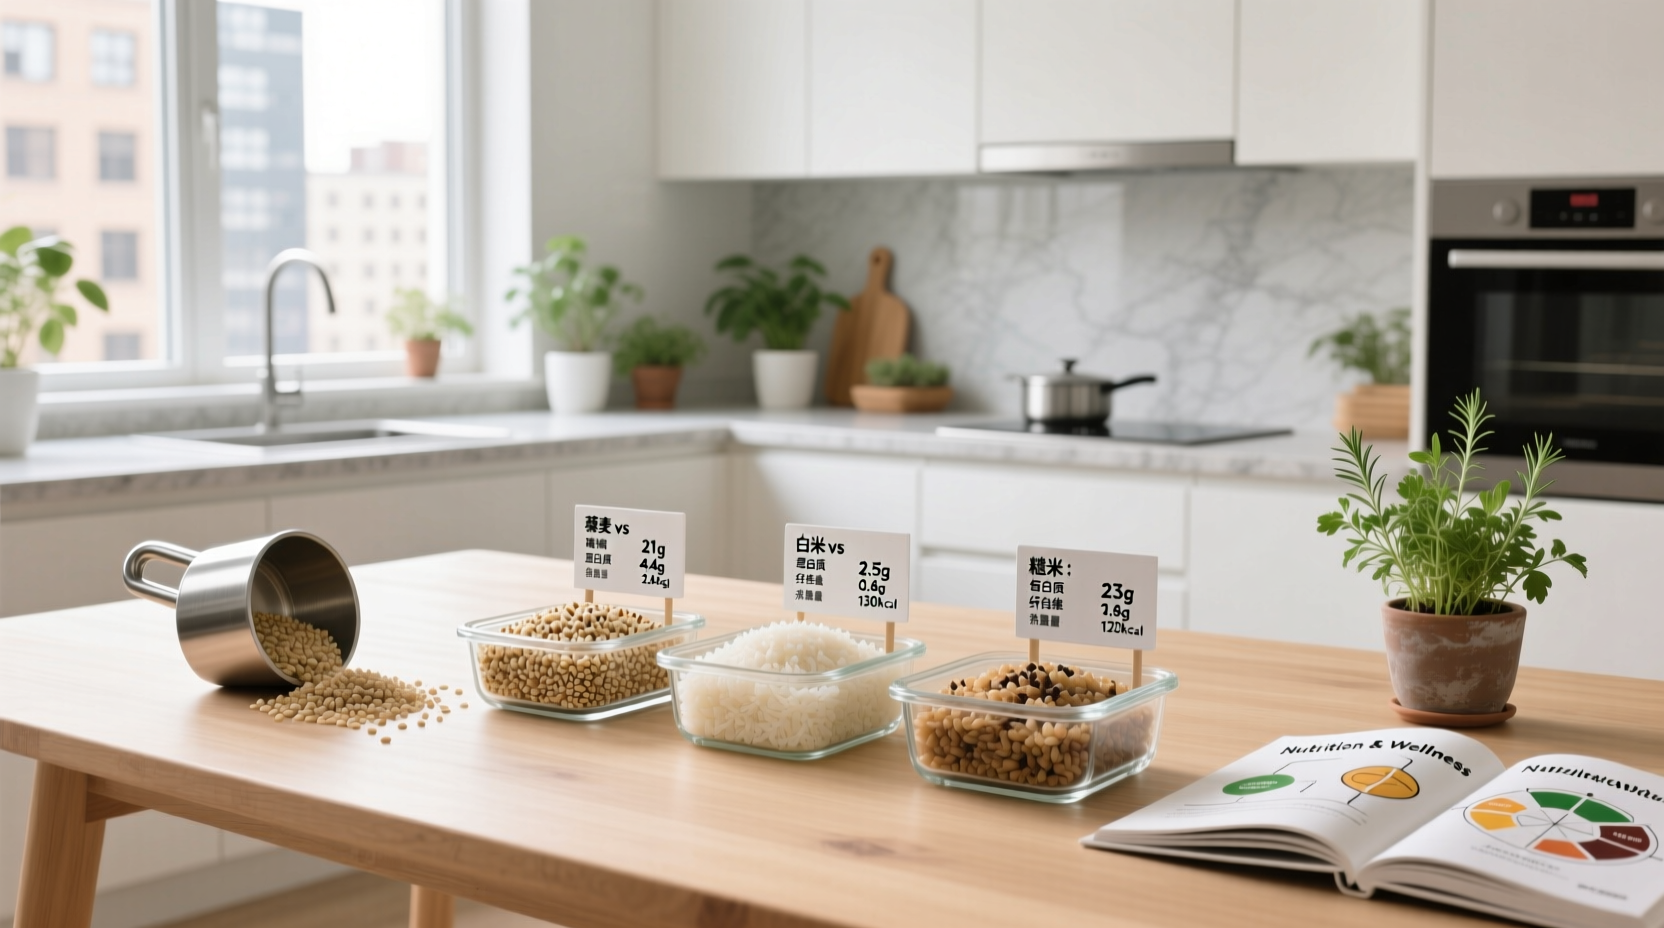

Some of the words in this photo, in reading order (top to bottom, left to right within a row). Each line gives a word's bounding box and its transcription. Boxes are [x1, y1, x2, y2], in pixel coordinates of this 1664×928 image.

[614, 524, 630, 535] vs
[641, 539, 666, 559] 21g
[796, 533, 826, 555] 白米
[828, 543, 845, 555] vs
[858, 560, 891, 582] 2.5g
[1100, 582, 1135, 605] 23g
[1280, 741, 1364, 755] Nutrition
[1369, 739, 1383, 749] &
[1391, 740, 1472, 777] Wellness
